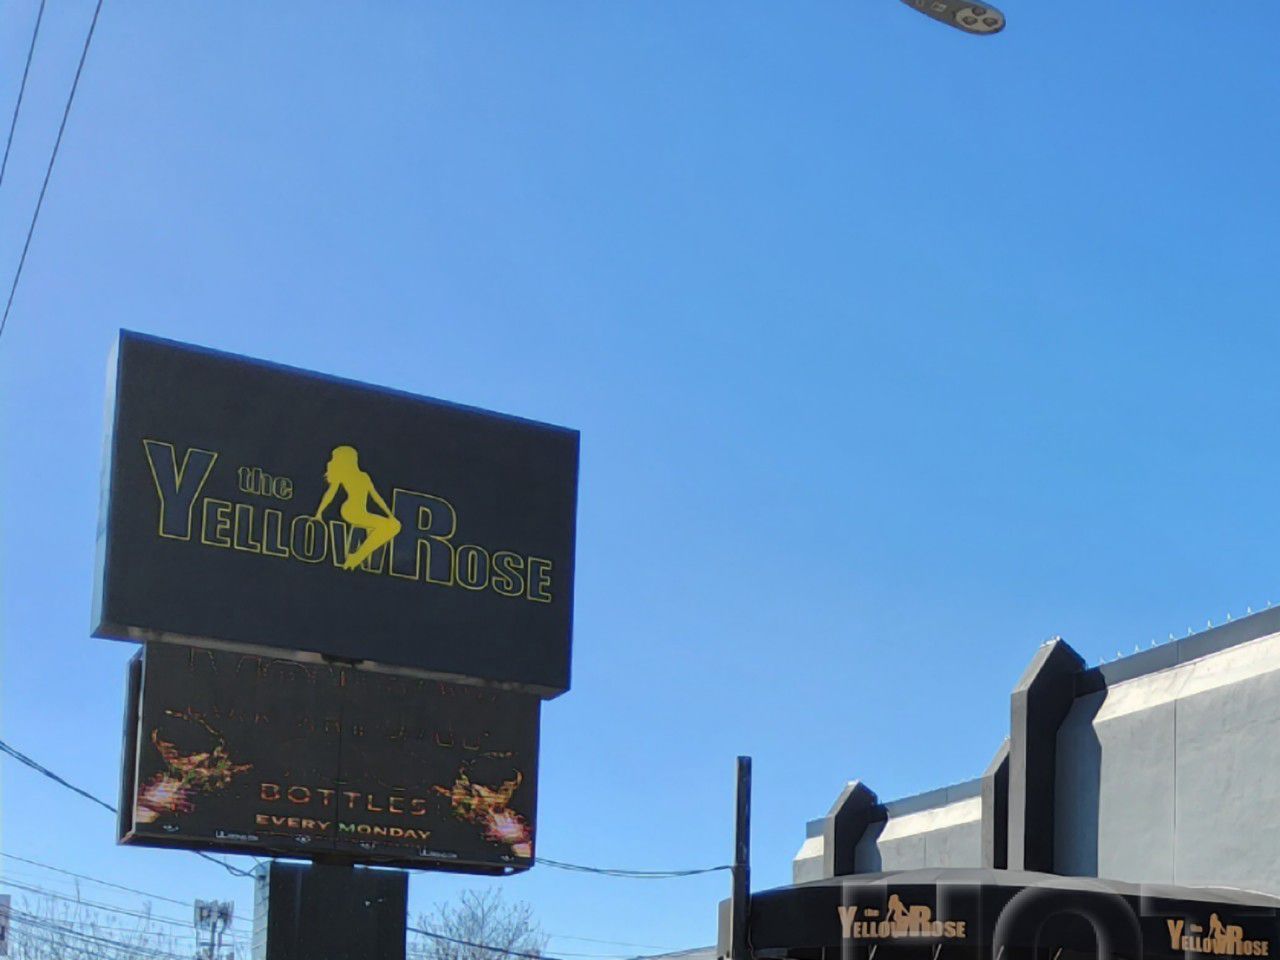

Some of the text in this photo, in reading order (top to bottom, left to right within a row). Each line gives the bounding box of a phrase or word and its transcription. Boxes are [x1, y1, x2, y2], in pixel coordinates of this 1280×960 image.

[238, 466, 294, 500] the
[388, 487, 553, 603] ROSE
[260, 782, 427, 816] BOTTLES
[255, 813, 432, 841] EVERY MONDAY
[907, 904, 967, 938] ROSE
